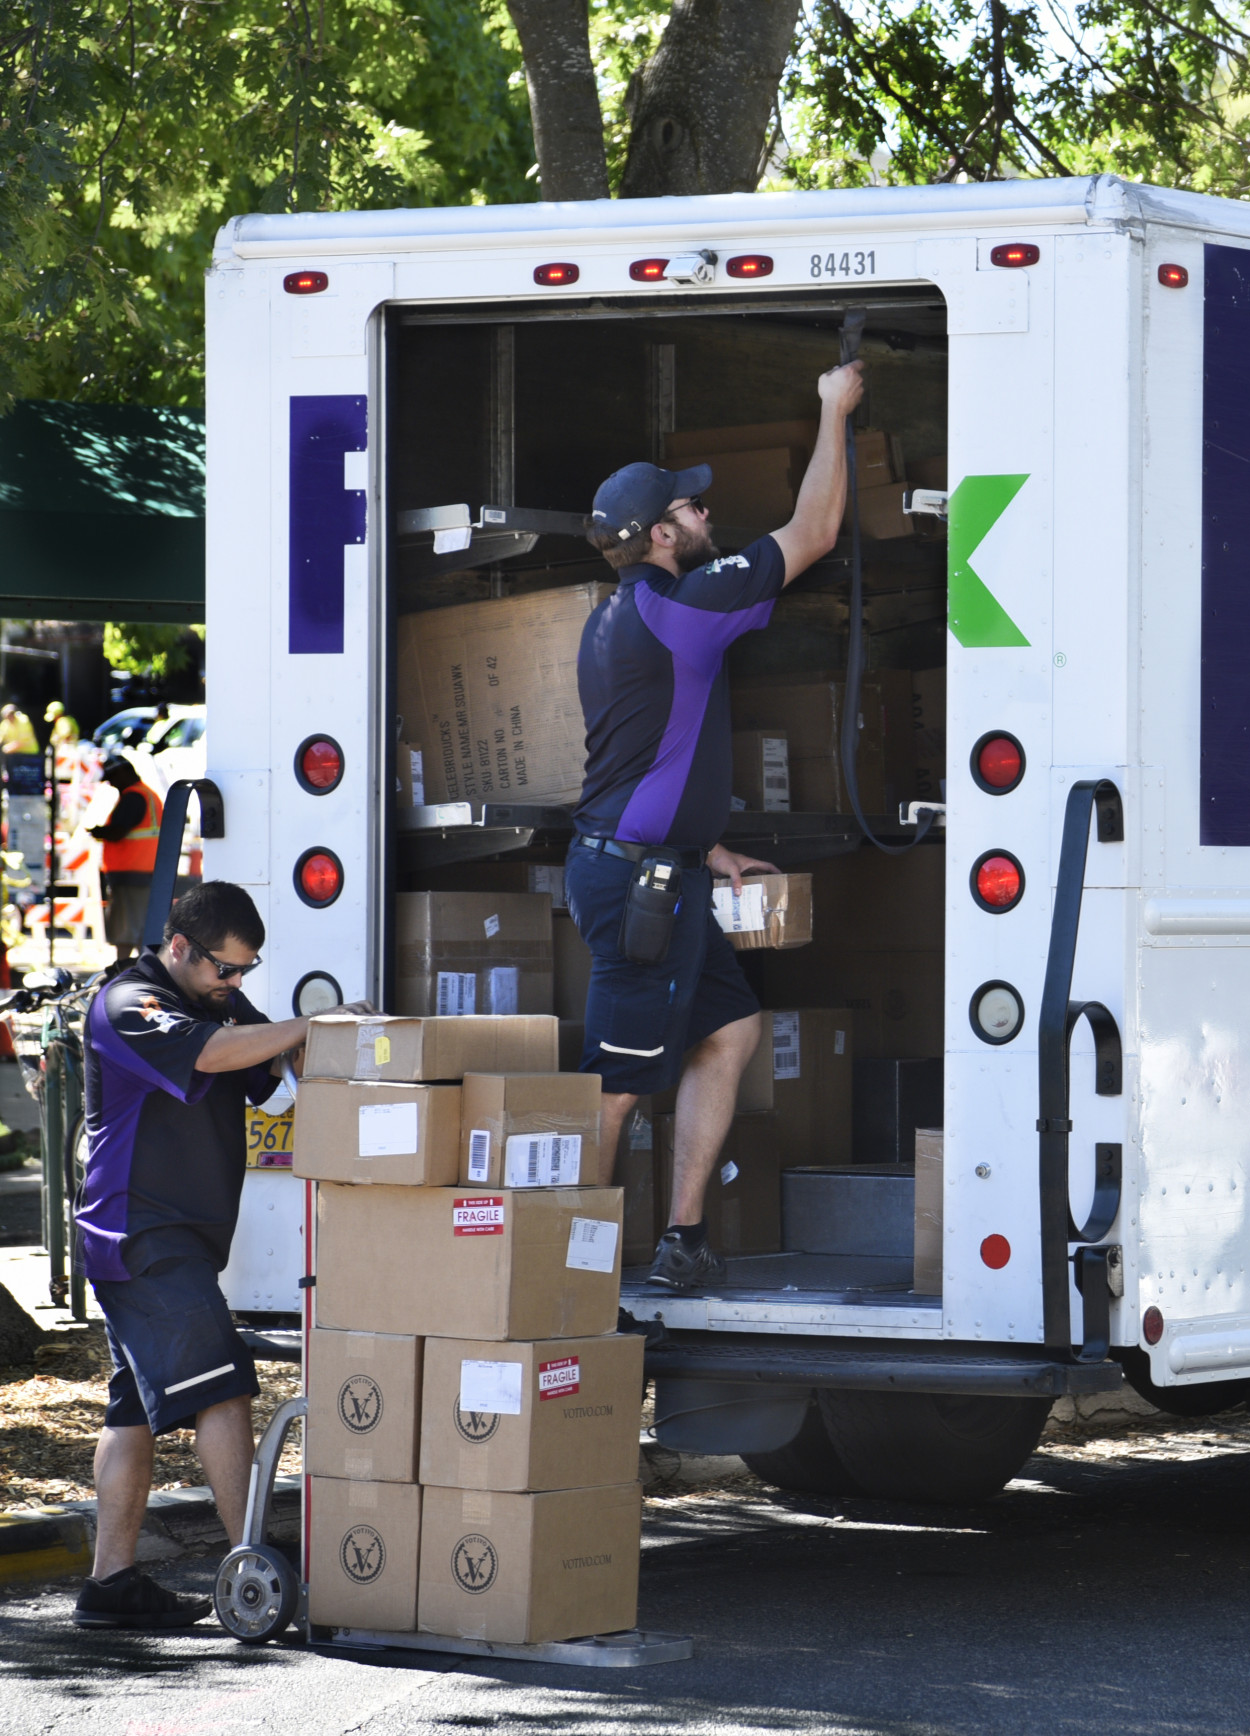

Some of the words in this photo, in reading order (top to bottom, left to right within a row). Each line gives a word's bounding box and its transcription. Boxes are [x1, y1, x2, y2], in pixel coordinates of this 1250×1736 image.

[810, 250, 876, 278] 84431
[486, 656, 497, 670] 42
[451, 663, 466, 708] SQUAWK
[488, 673, 499, 687] OF
[510, 704, 523, 736] CHINA
[477, 739, 490, 767] 81122
[513, 740, 524, 751] IN
[440, 720, 460, 800] CELEBRIDUCKS
[496, 748, 510, 789] CARTON
[515, 756, 528, 786] MADE
[462, 763, 477, 797] STYLE
[457, 1210, 500, 1222] FRAGILE
[350, 1378, 374, 1387] VOTIVO
[543, 1369, 577, 1386] FRAGILE
[563, 1405, 613, 1419] VOTIVO.COM
[352, 1527, 376, 1537] VOTIVO
[465, 1536, 488, 1547] VOTIVO
[562, 1553, 612, 1569] VOTIVO.COM
